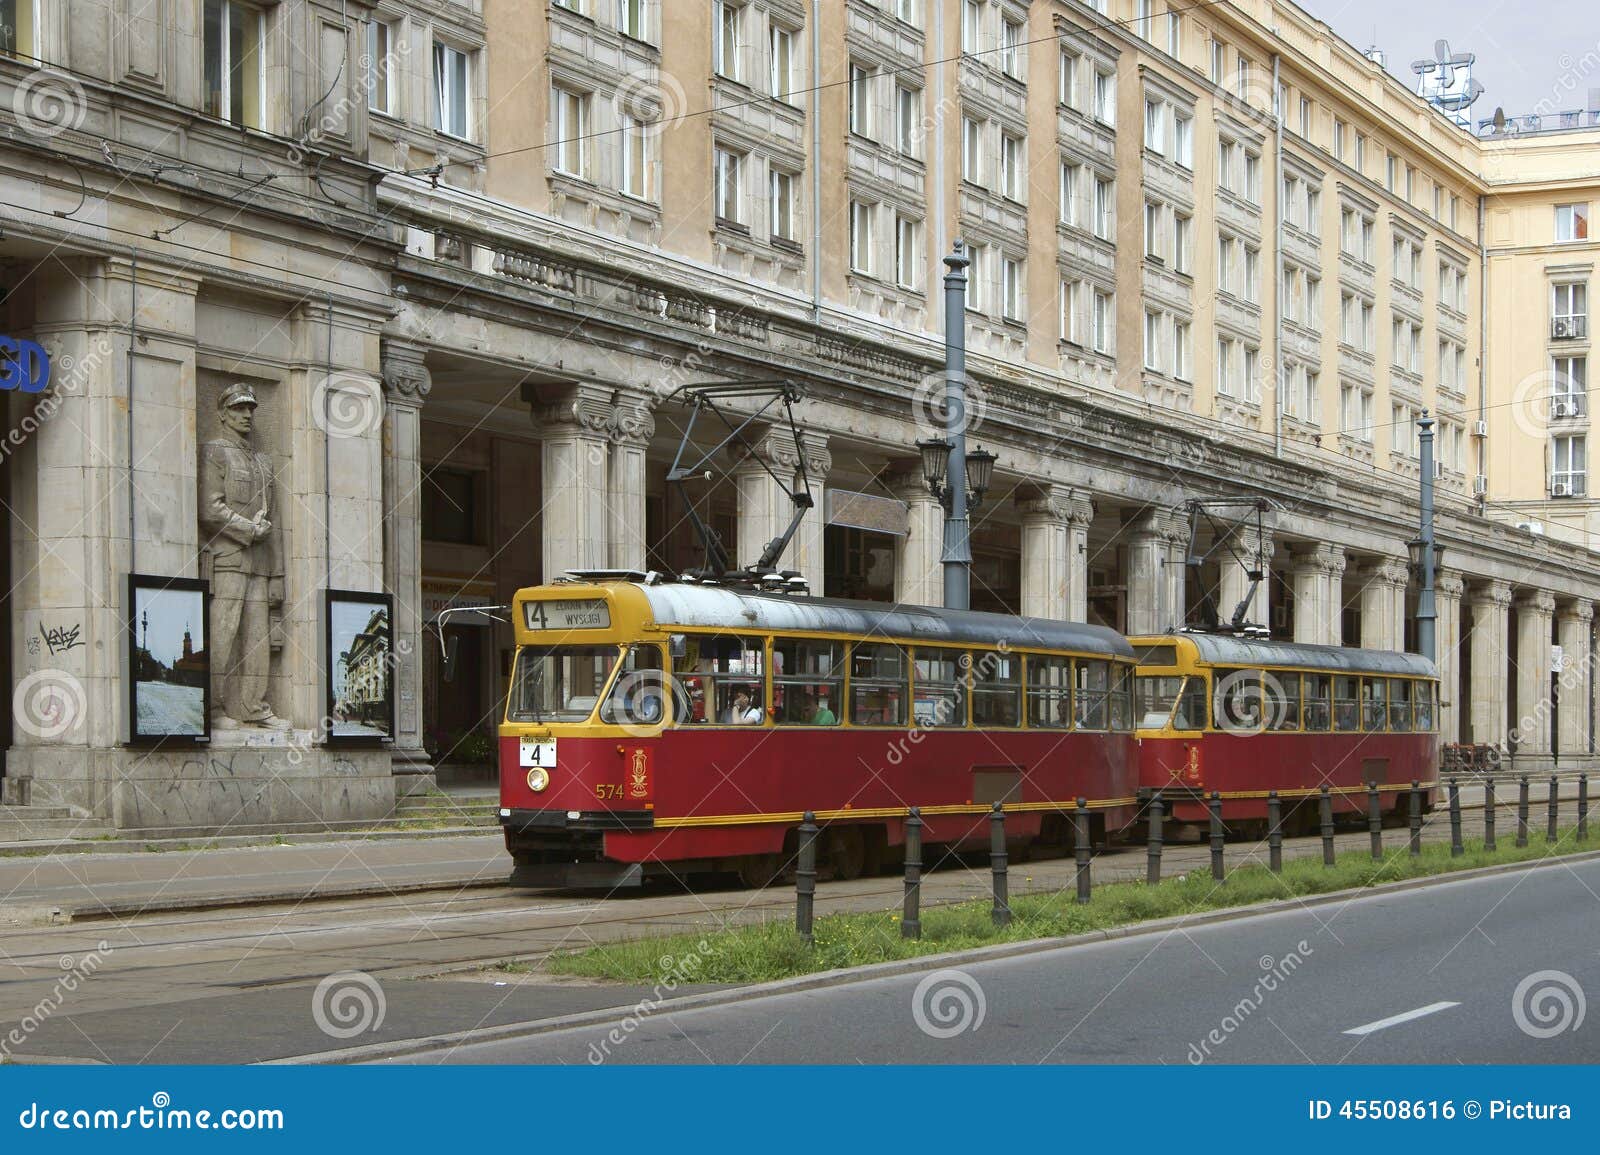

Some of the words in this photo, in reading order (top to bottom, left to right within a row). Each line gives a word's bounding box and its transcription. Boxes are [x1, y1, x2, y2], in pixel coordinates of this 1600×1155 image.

[531, 602, 548, 628] 4
[531, 745, 541, 765] 4
[596, 784, 624, 799] 574
